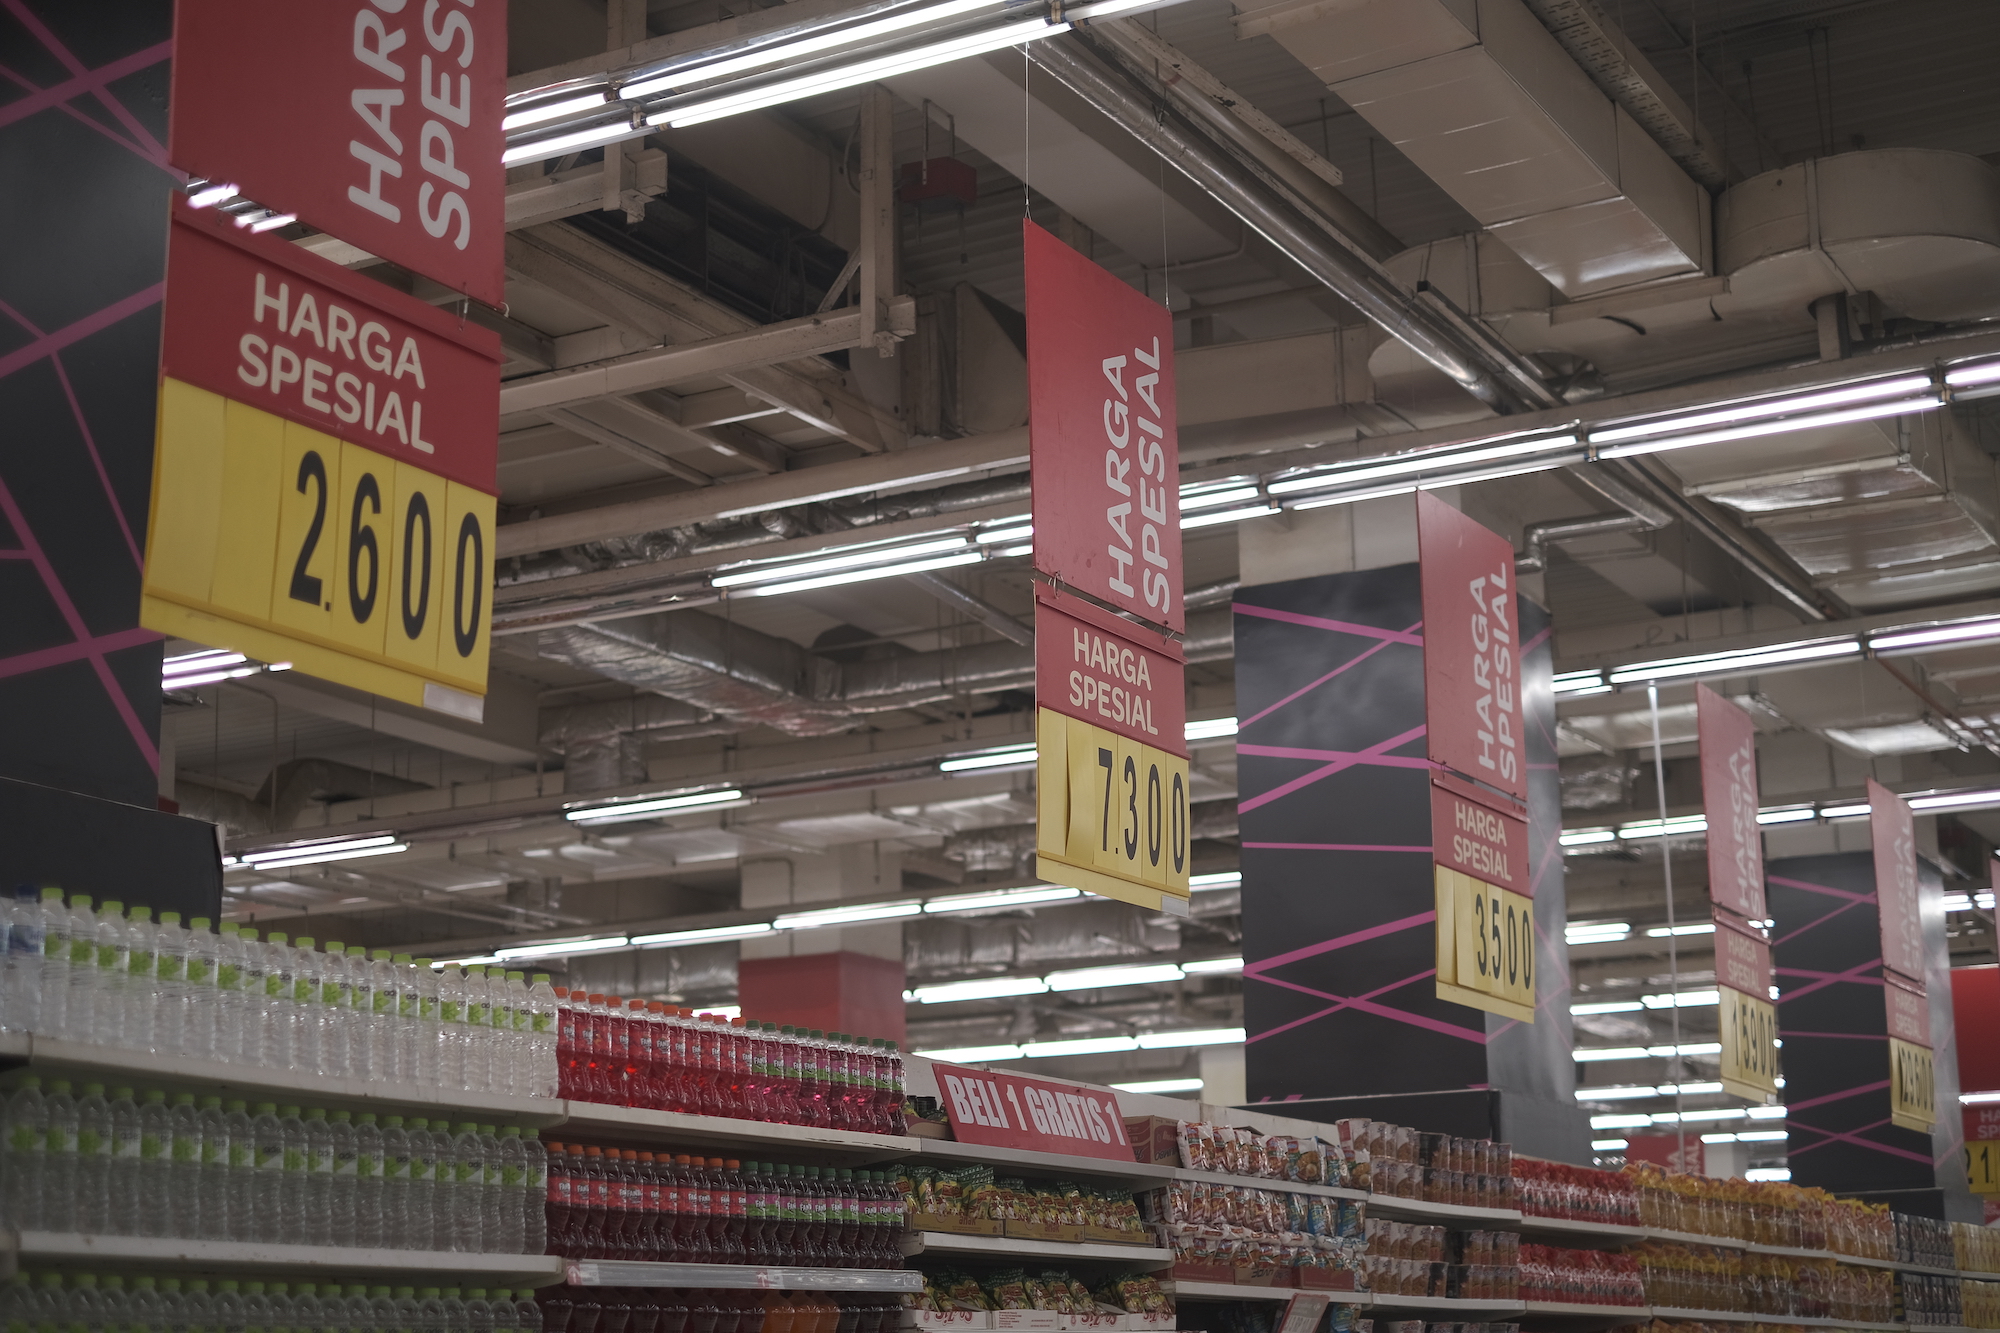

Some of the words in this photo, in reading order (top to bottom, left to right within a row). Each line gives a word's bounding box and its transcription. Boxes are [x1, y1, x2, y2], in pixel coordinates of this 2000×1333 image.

[348, 0, 407, 223] HAR
[254, 272, 426, 390] HARGA
[237, 333, 435, 455] SPESIAL
[1102, 354, 1134, 598] HARGA
[1134, 336, 1170, 614] SPESIAL
[289, 450, 484, 658] 2.600
[1069, 670, 1158, 735] SPESIAL
[1073, 627, 1152, 691] HARGA
[1470, 576, 1495, 770] HARGA
[1491, 562, 1517, 784] SPESIAL
[1098, 747, 1185, 874] 7.300
[1453, 835, 1512, 881] SPESIAL
[1455, 801, 1507, 847] HARGA
[1729, 752, 1749, 908] HARGA
[1740, 737, 1761, 917] SPESIAL
[1475, 894, 1531, 989] 3.500
[1727, 931, 1758, 965] HARGA
[1727, 960, 1761, 993] SPESIAL
[944, 1074, 1010, 1128] BELI
[1006, 1084, 1028, 1131] 1
[1023, 1086, 1111, 1144] GRATIS
[1104, 1101, 1126, 1146] 1
